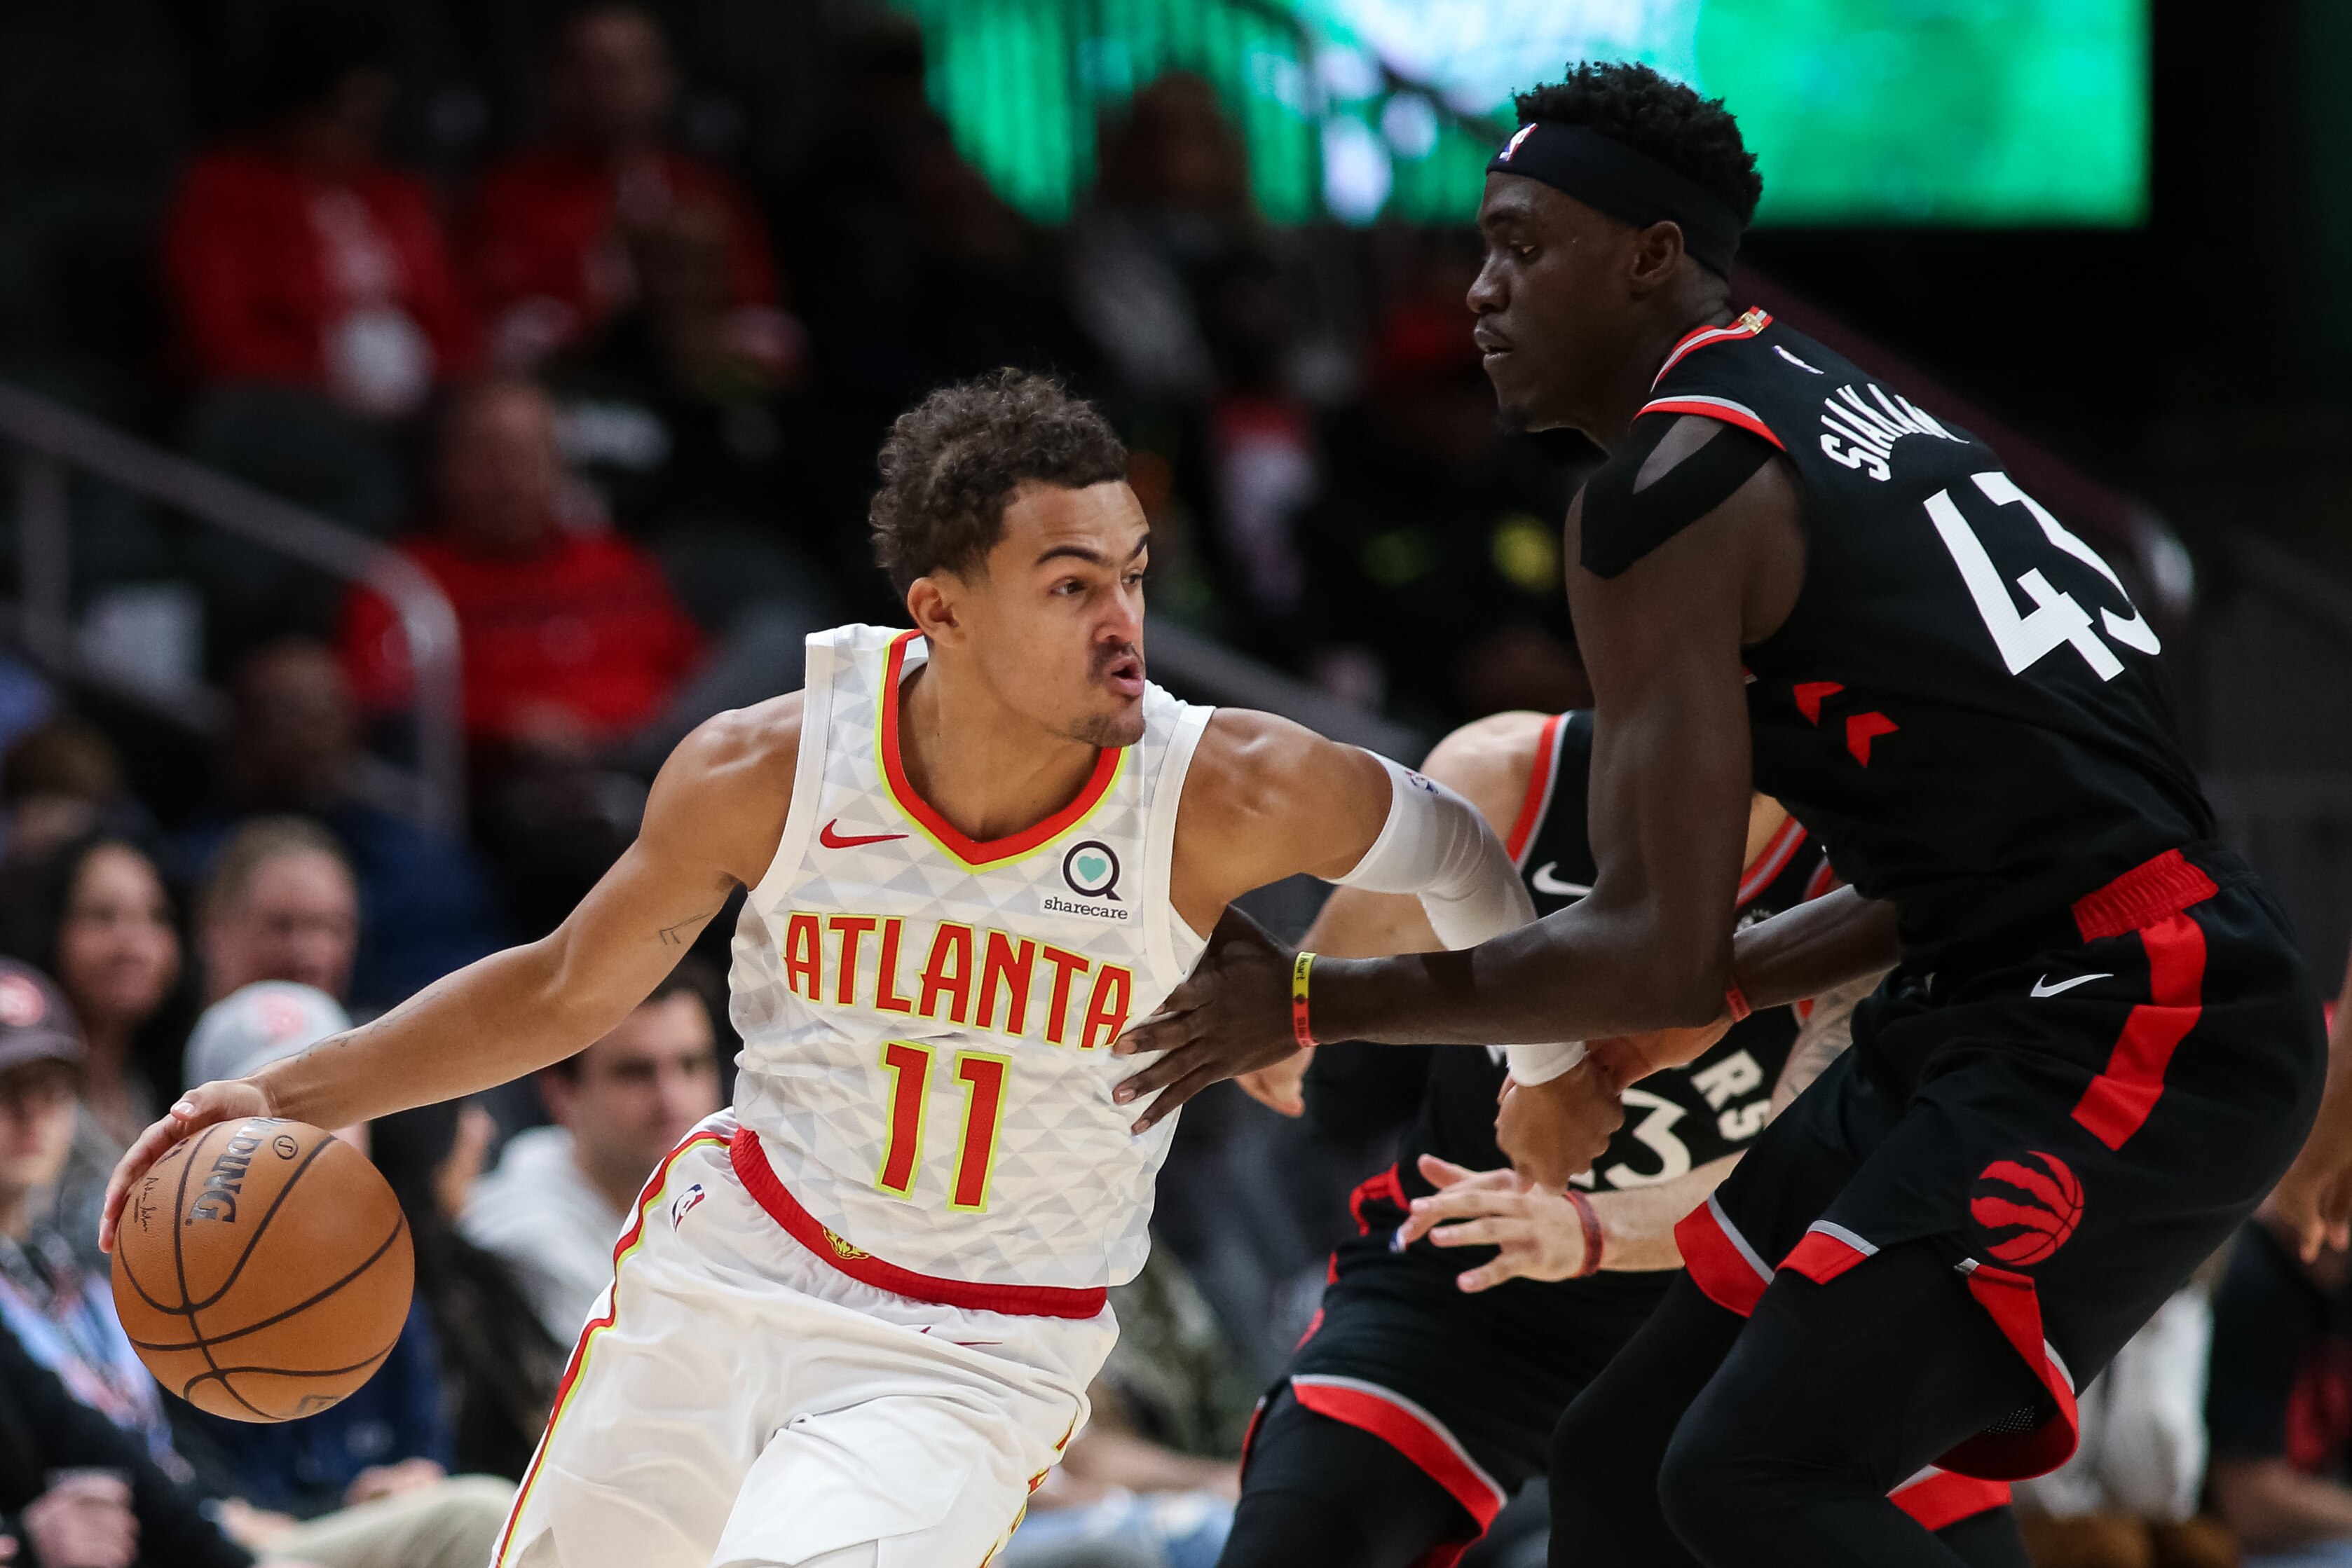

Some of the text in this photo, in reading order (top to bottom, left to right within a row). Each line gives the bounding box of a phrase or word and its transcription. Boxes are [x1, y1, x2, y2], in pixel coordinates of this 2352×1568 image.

[1924, 471, 2161, 682] 43
[1044, 896, 1128, 920] sharecare
[781, 910, 1135, 1051] ATLANTA
[874, 1038, 1012, 1213] 11
[1568, 1087, 1691, 1190] 3
